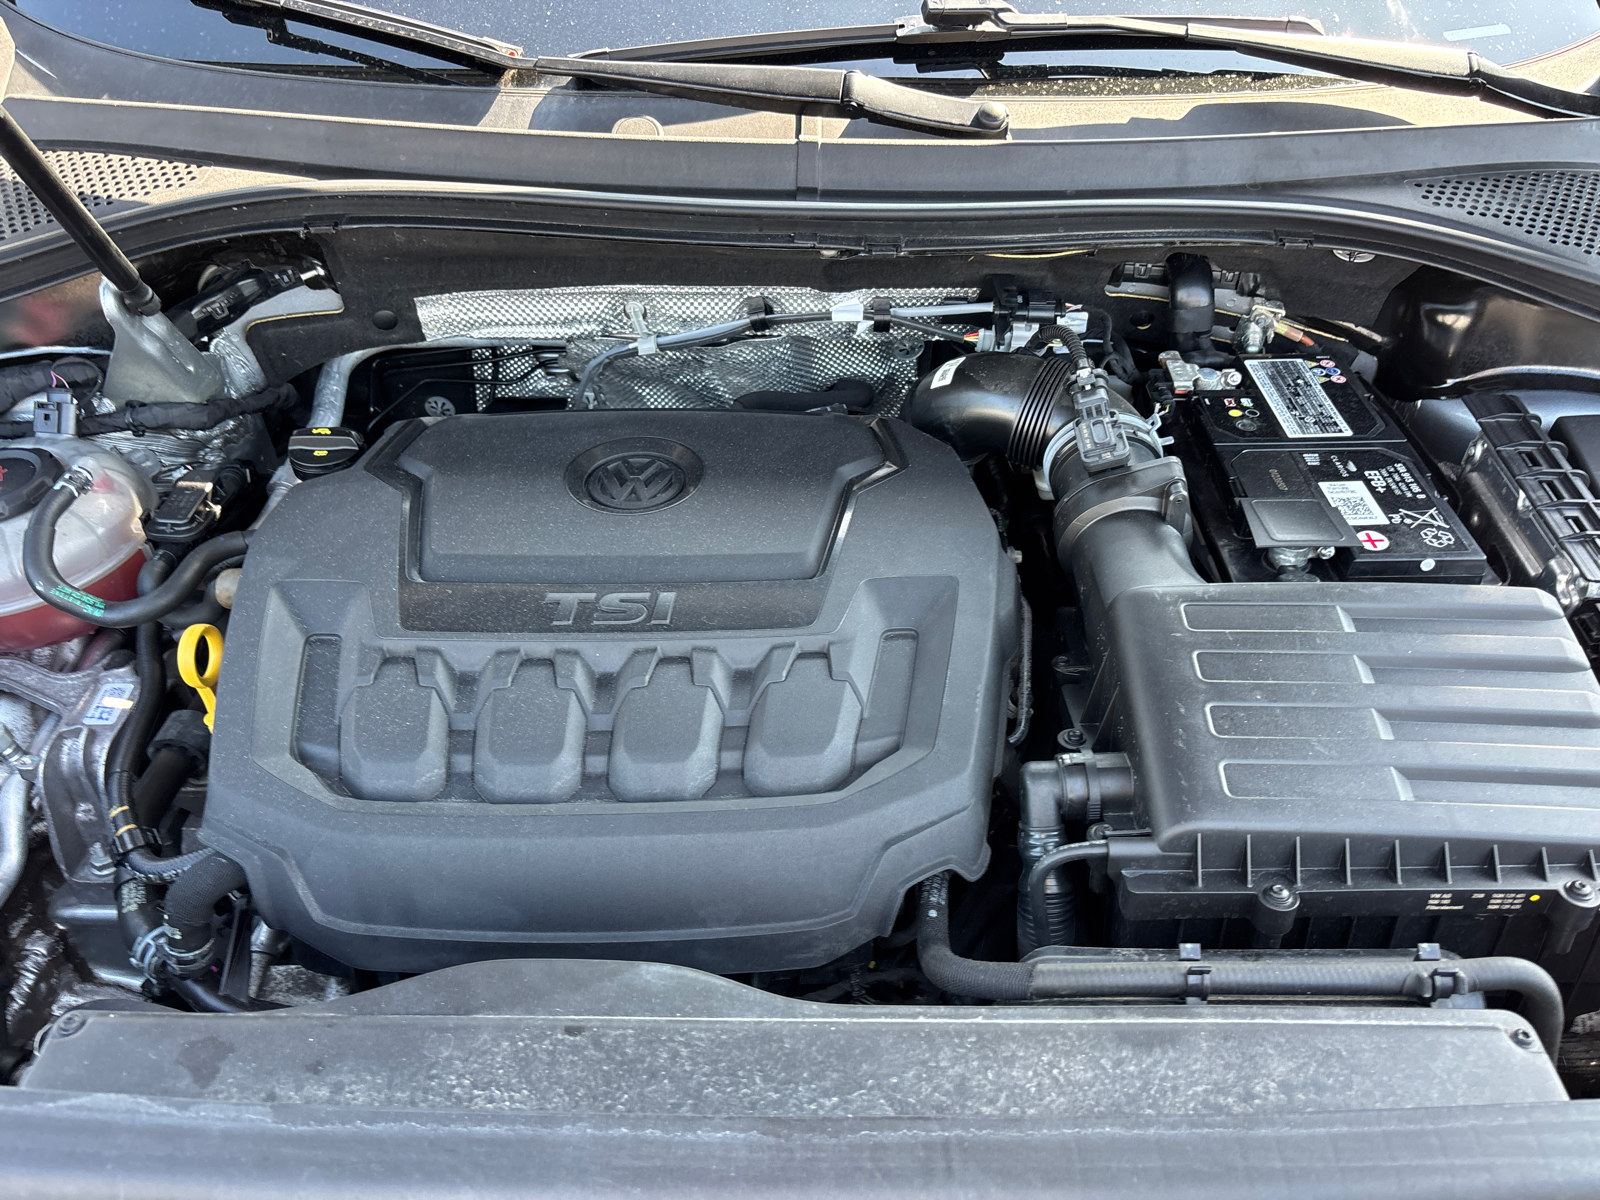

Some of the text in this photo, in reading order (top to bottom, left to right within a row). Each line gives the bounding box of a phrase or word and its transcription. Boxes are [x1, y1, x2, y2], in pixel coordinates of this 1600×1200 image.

[1331, 455, 1349, 477] CLARIOS
[1364, 470, 1387, 493] EFB+
[1401, 473, 1414, 482] 915
[1388, 513, 1402, 524] Pb
[545, 592, 676, 625] TSI
